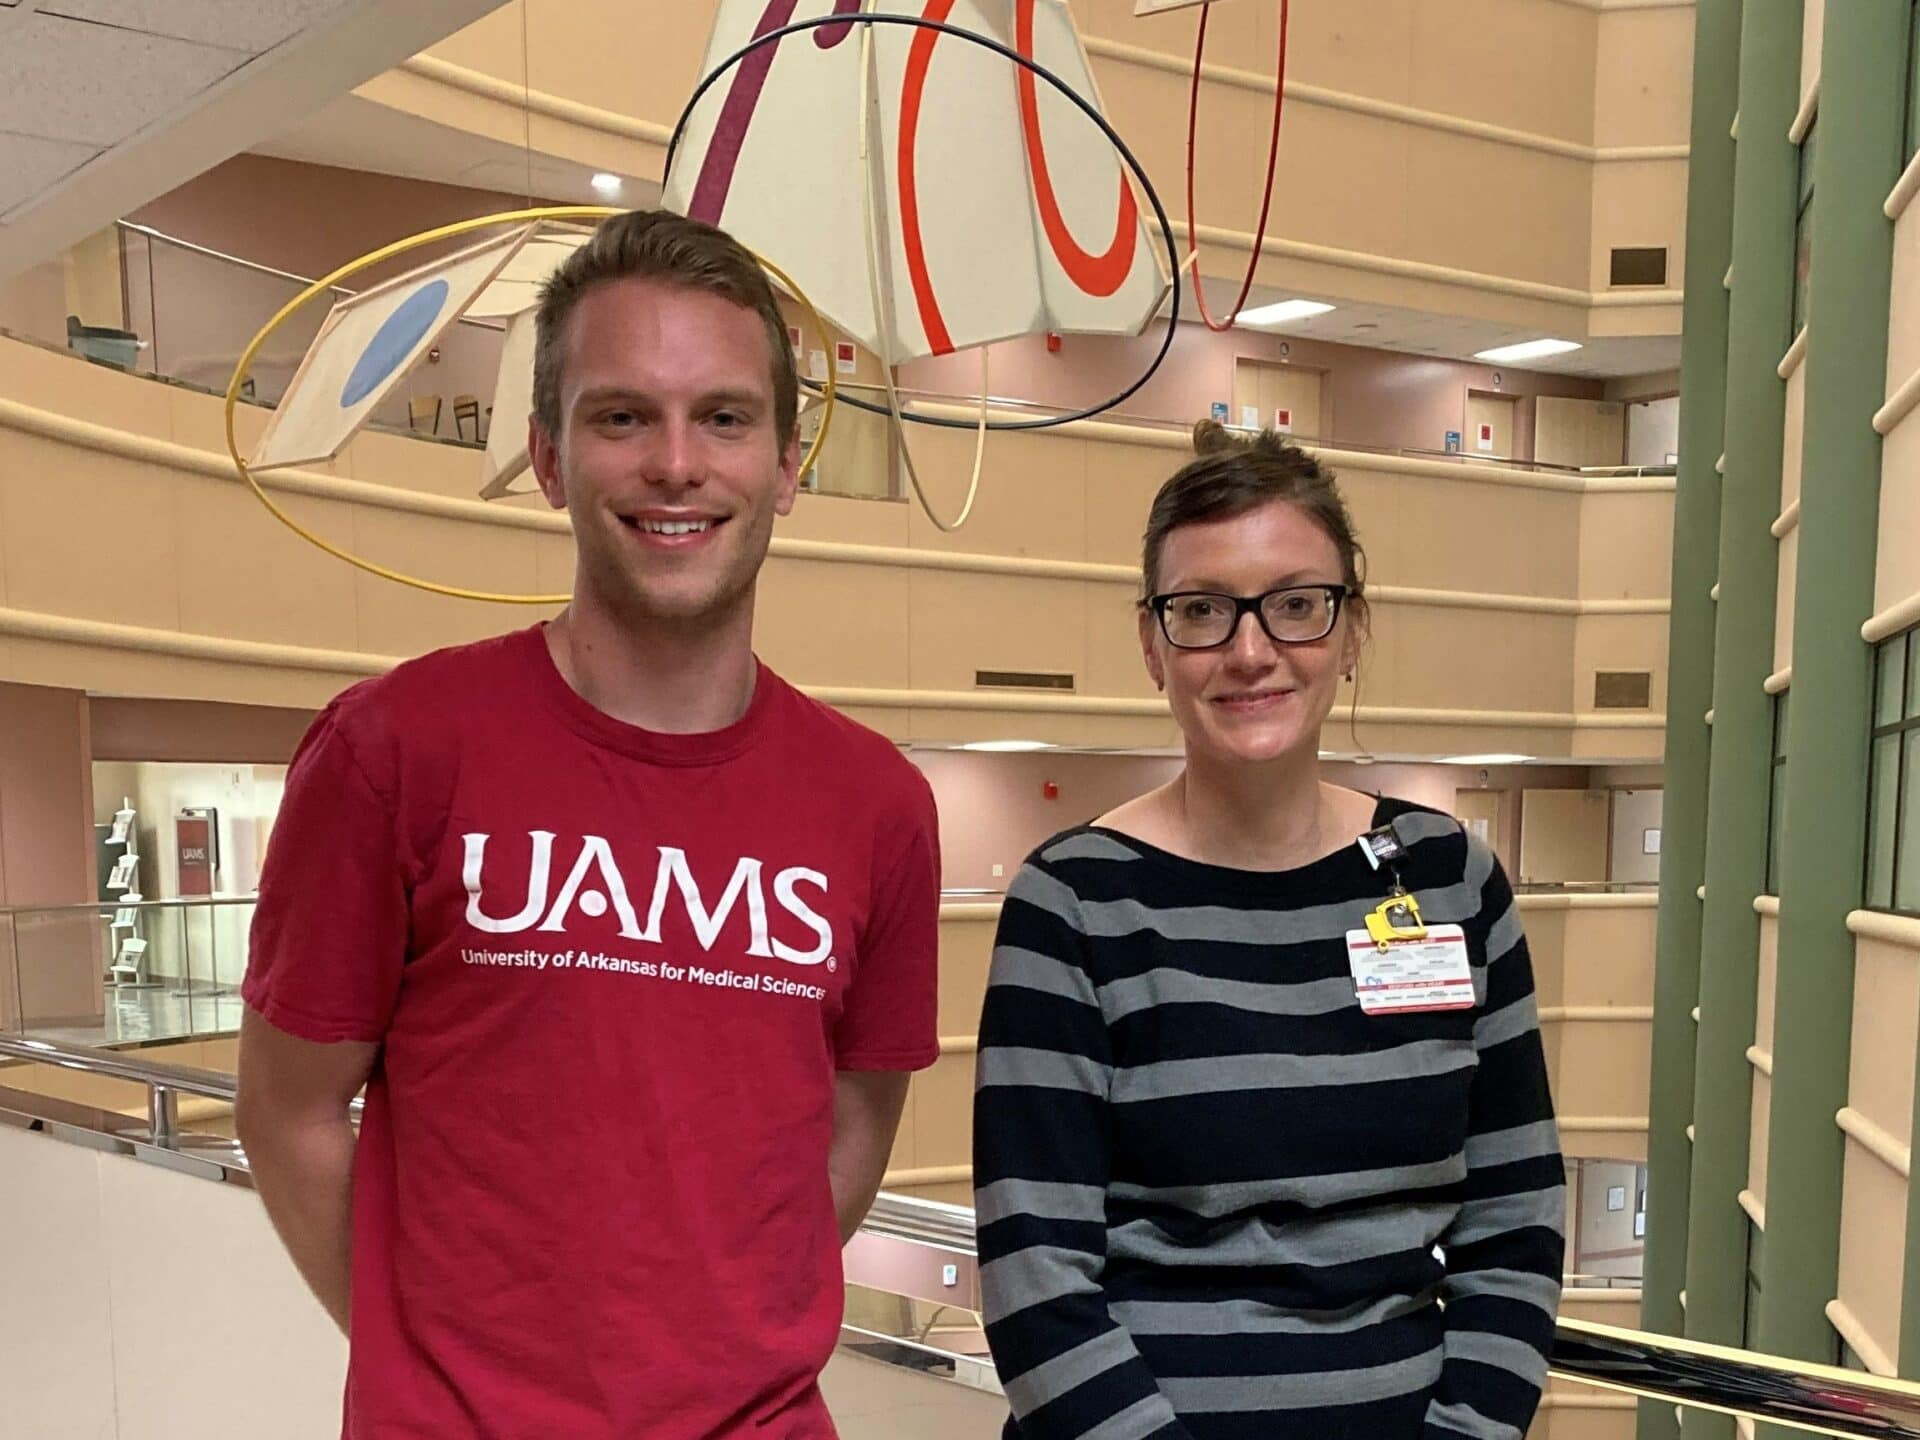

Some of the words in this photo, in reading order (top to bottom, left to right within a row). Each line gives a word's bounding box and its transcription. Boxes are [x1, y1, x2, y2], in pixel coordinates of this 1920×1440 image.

[461, 829, 833, 966] UAMS
[461, 948, 549, 970] University
[551, 950, 574, 968] of
[575, 951, 658, 977] Arkansas
[660, 961, 686, 981] for
[687, 965, 760, 991] Medical
